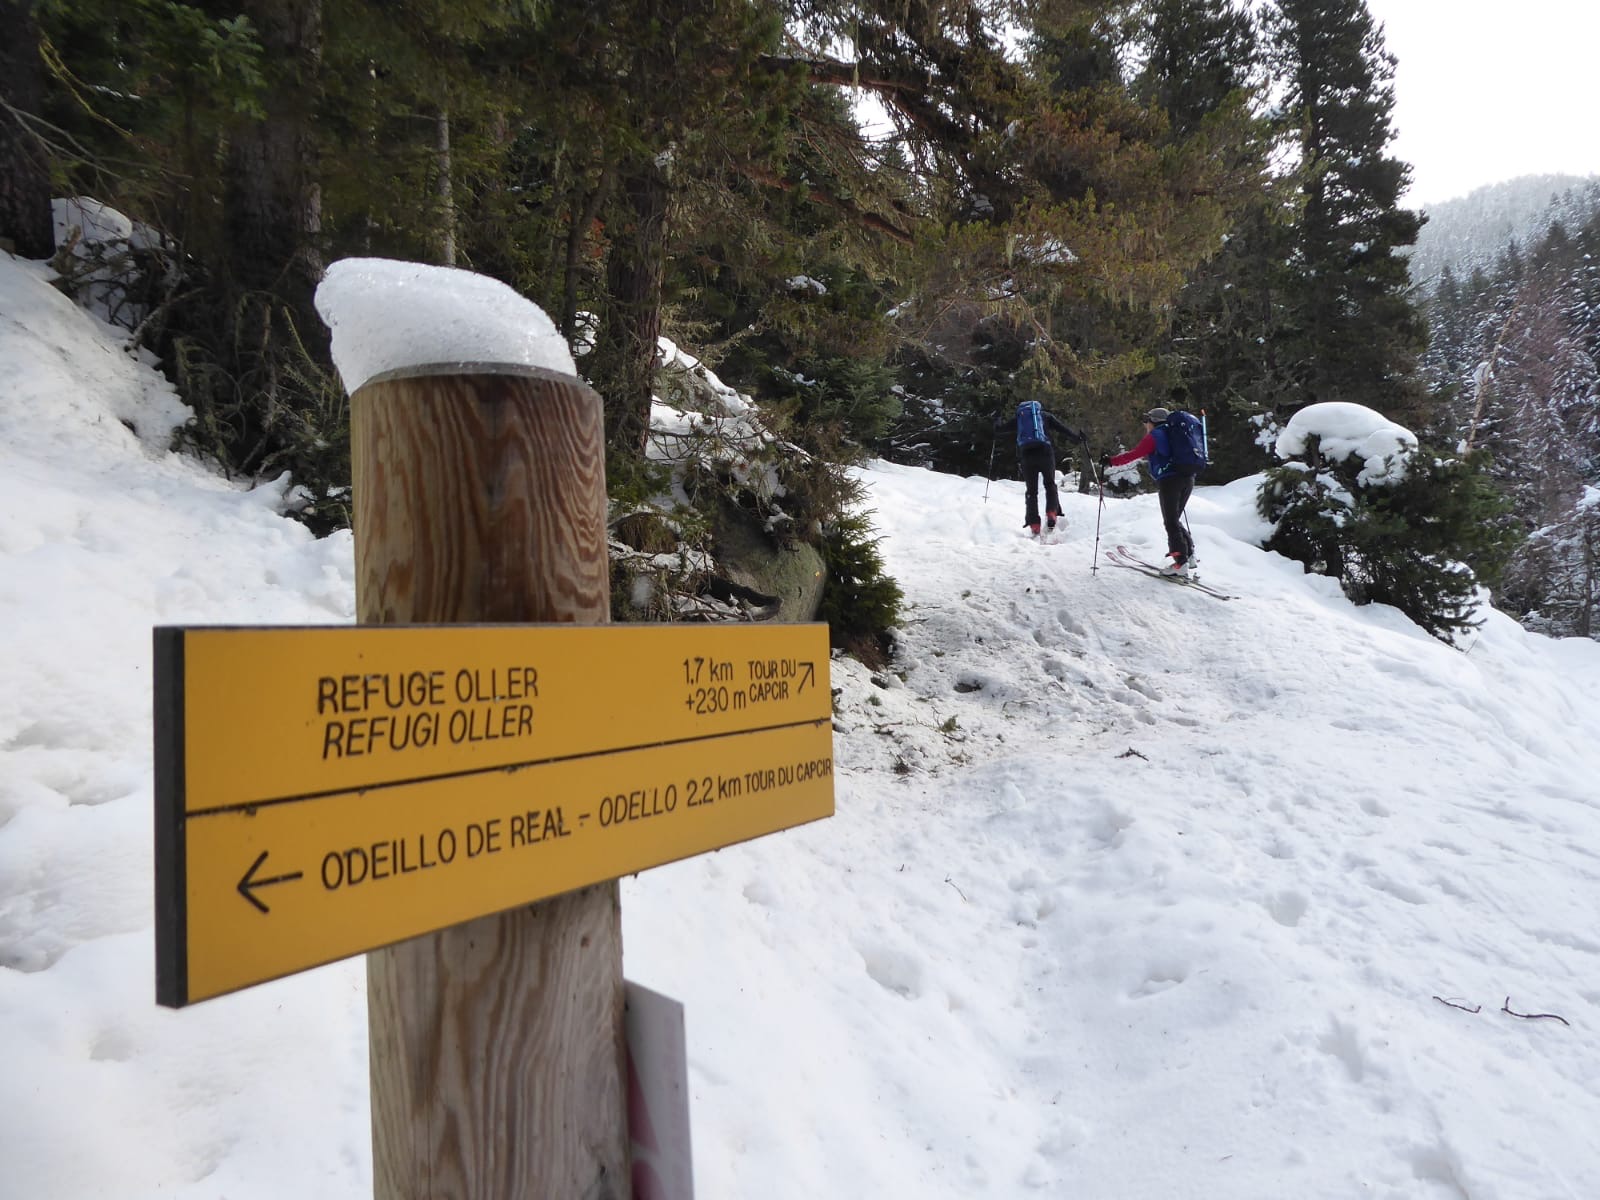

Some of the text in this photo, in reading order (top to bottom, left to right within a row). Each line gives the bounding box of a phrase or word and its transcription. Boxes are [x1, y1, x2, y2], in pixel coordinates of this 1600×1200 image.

[683, 657, 733, 686] 1.7 km
[748, 659, 796, 681] TOUR DU
[317, 667, 539, 715] REFUGE OLLER
[685, 686, 746, 714] +230 m
[749, 681, 789, 703] CAPCIR
[322, 704, 534, 760] REFUGI OLLER
[321, 828, 456, 890] ODEILLO
[466, 819, 501, 858] DE
[510, 806, 571, 849] REAL
[599, 784, 677, 827] ODELLO
[718, 775, 741, 800] km
[745, 769, 775, 794] TOUR
[778, 764, 794, 785] DU
[796, 758, 832, 783] CAPCIR
